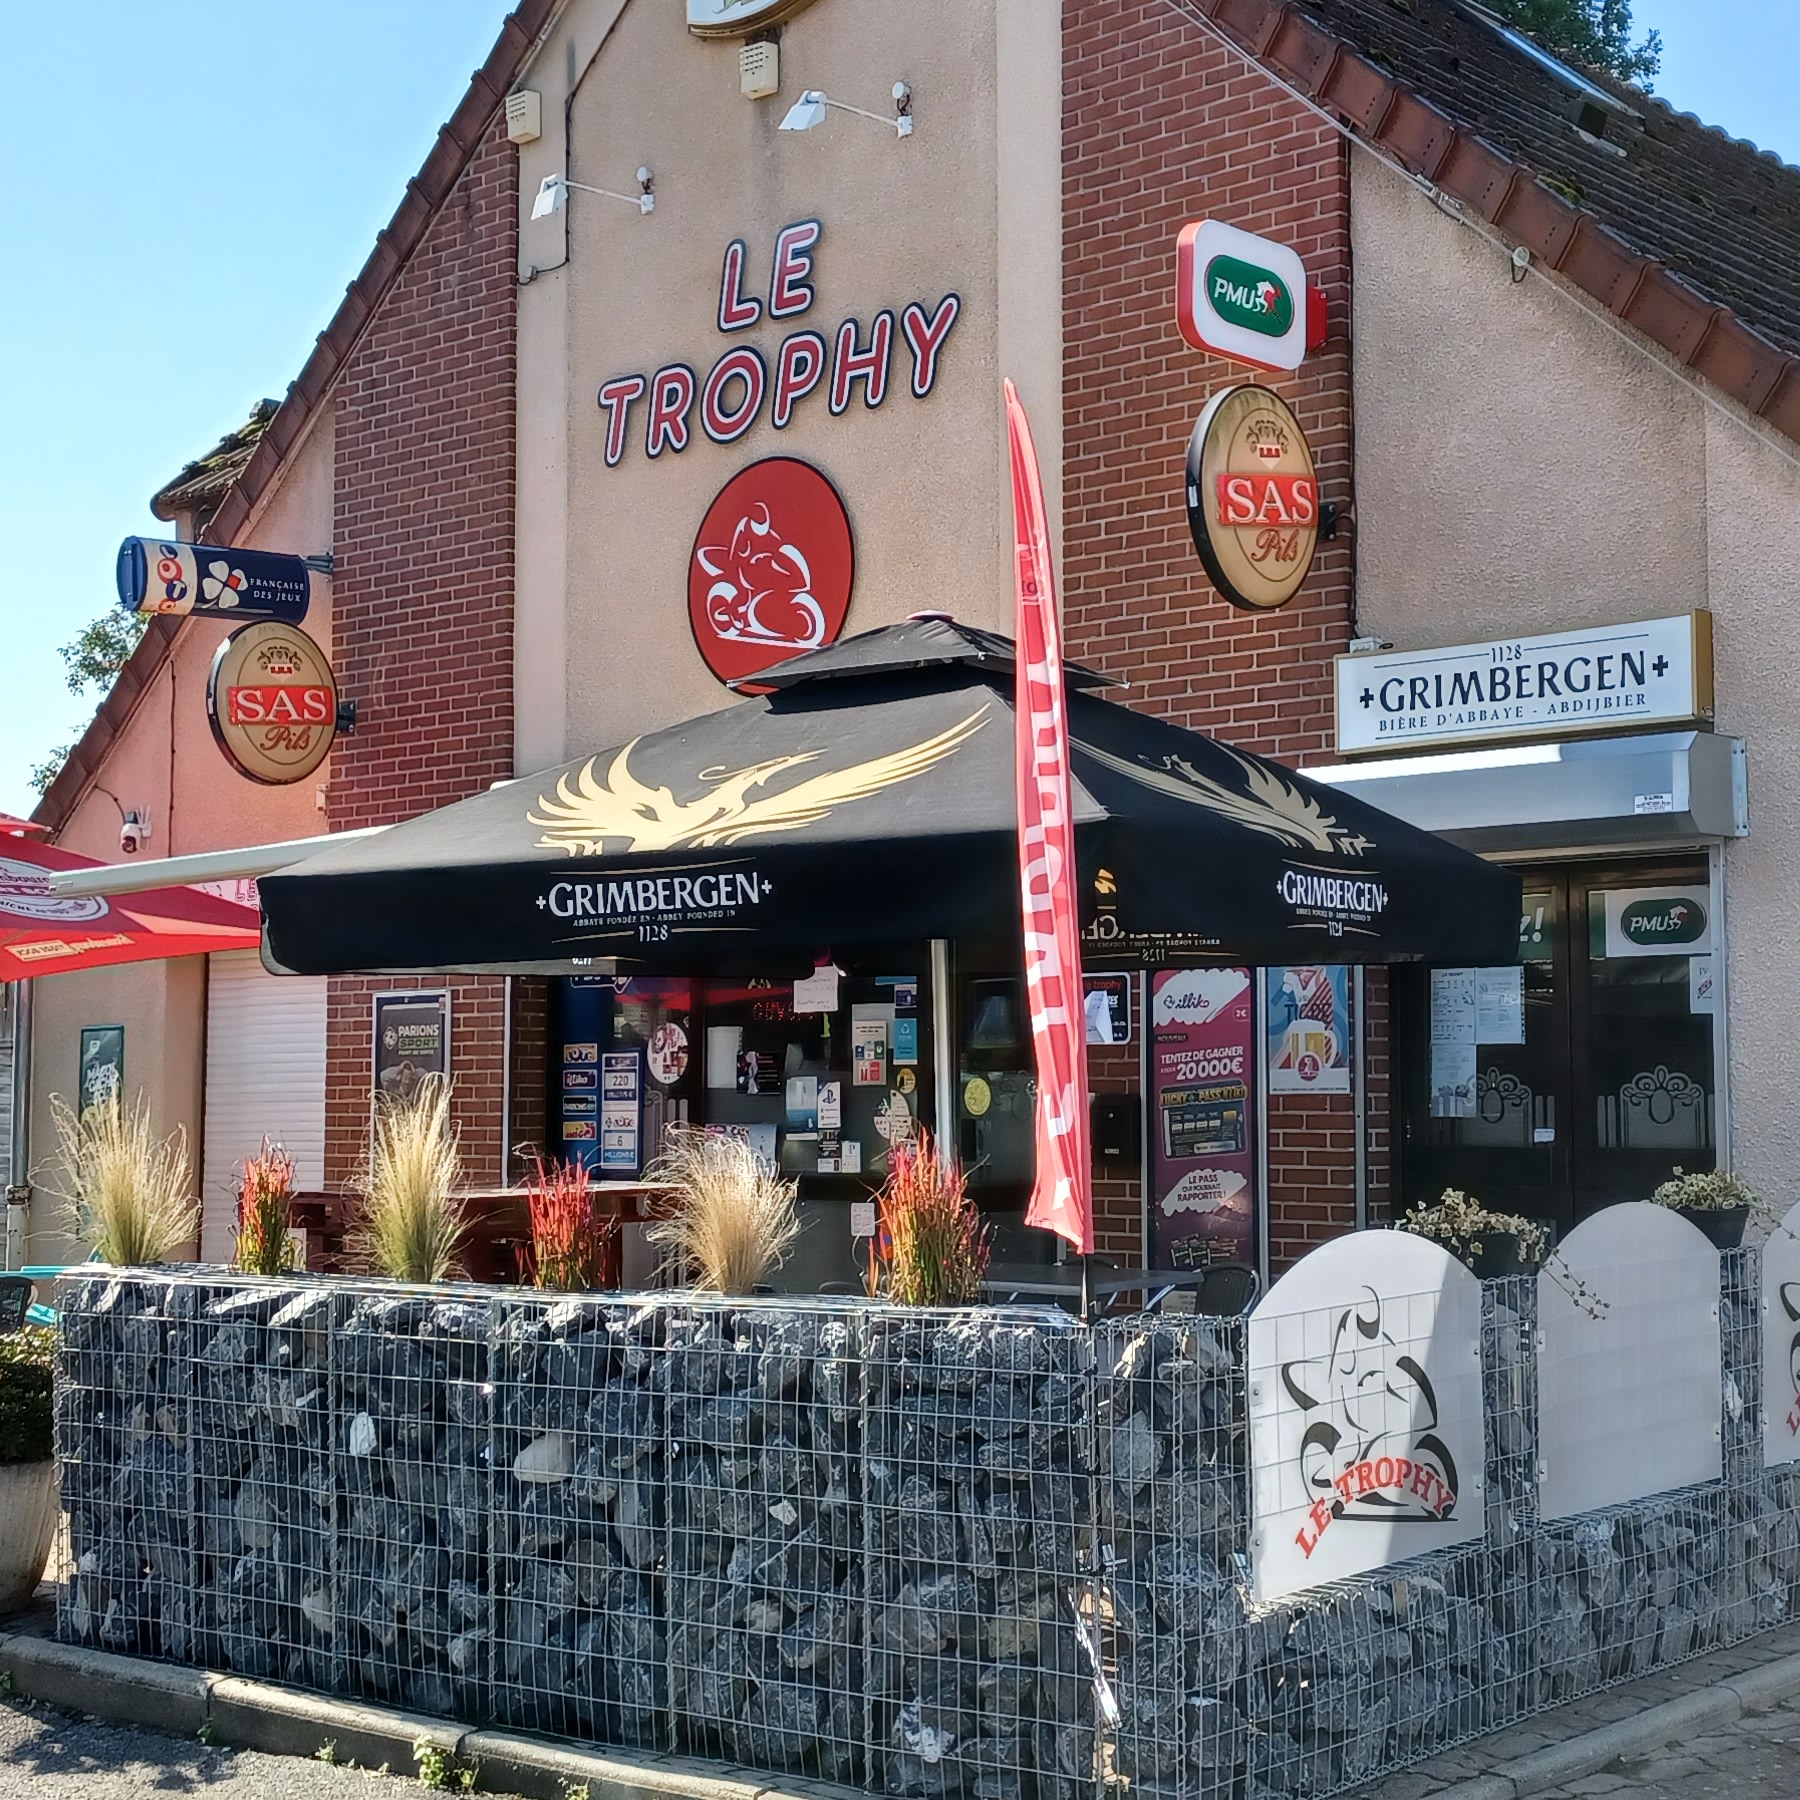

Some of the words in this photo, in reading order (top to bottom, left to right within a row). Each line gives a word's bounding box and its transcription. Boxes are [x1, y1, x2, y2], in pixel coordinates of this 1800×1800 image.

[717, 218, 823, 332] LE
[1214, 277, 1255, 309] PMU
[598, 293, 960, 468] TROPHY
[1226, 478, 1313, 524] SAS
[1251, 528, 1298, 564] Pils
[250, 578, 305, 591] FRANÇAISE
[253, 590, 272, 600] DES
[276, 593, 300, 602] JEUX
[1491, 645, 1523, 664] 1128
[1380, 650, 1646, 713] GRIMBERGEN
[235, 689, 327, 722] SAS
[1379, 713, 1428, 732] BIÈRE
[1437, 706, 1524, 726] D'ABBAYE
[1547, 693, 1647, 715] ABDIJBIER
[260, 726, 311, 751] Pils
[548, 871, 760, 917] GRIMBERGEN
[1283, 870, 1383, 913] GRIMBERGEN
[639, 925, 668, 942] 1128
[1630, 915, 1668, 933] PMU
[1175, 992, 1209, 1009] illiko
[398, 1024, 439, 1037] PARIONS
[400, 1038, 438, 1048] SPORT
[1161, 1051, 1192, 1064] TENTEZ
[1193, 1049, 1204, 1061] DE
[1205, 1045, 1244, 1059] GAGNER
[612, 1075, 629, 1087] 220
[617, 1135, 623, 1147] 6
[1188, 1176, 1197, 1185] LE
[1198, 1173, 1218, 1184] PASS
[1295, 1497, 1333, 1559] LE
[1334, 1456, 1454, 1516] TROPHY
